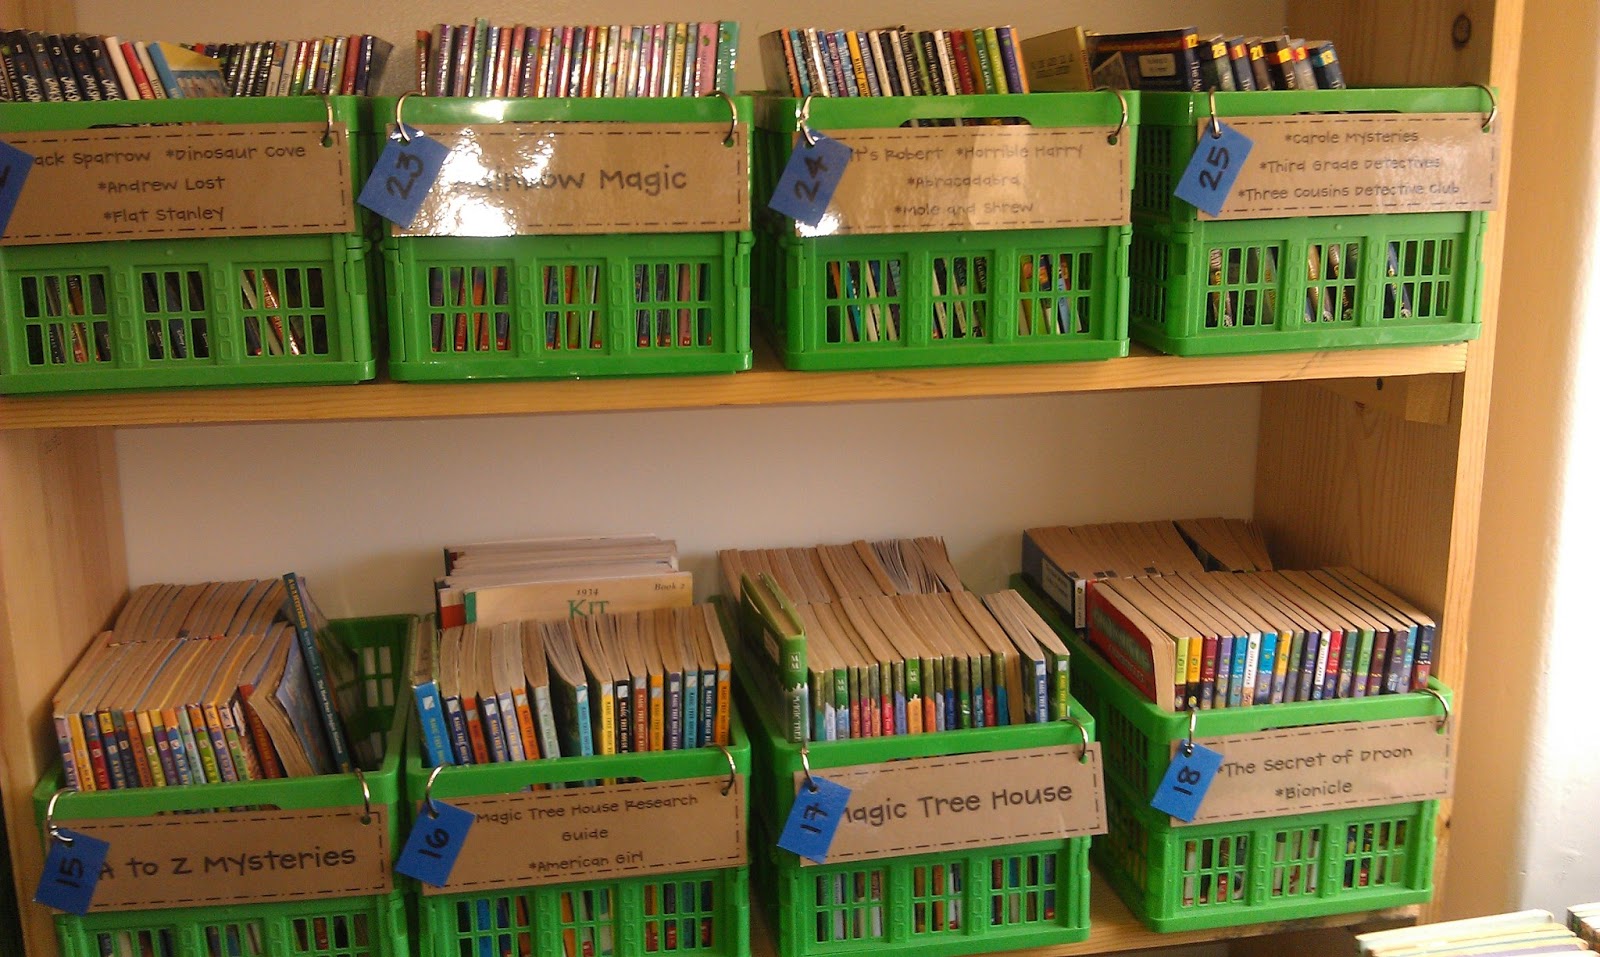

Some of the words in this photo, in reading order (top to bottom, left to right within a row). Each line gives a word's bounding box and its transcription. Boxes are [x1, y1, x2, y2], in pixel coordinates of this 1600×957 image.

[1345, 130, 1418, 144] Mysteries
[34, 151, 65, 166] ack
[73, 151, 151, 168] Sparrow
[264, 145, 306, 158] Cove
[884, 147, 943, 161] Robert
[1035, 143, 1084, 158] Harry
[1312, 157, 1359, 171] Grade
[1364, 156, 1441, 170] Detectives
[386, 151, 425, 199] 23
[600, 164, 687, 196] Magic
[795, 154, 829, 203] 24
[1199, 146, 1230, 191] 25
[185, 176, 226, 191] Lost
[1295, 185, 1349, 198] Cousins
[1355, 184, 1424, 197] Detective
[1428, 182, 1460, 194] Club
[156, 206, 225, 222] Stanley
[947, 201, 975, 215] and
[983, 201, 1033, 214] Shrew
[654, 583, 676, 591] Book
[568, 599, 609, 618] KIT
[1264, 753, 1323, 771] Secret
[1333, 750, 1354, 765] of
[1361, 746, 1413, 760] Droon
[1173, 766, 1200, 796] 18
[476, 808, 522, 824] Magic
[528, 806, 565, 820] Tree
[571, 801, 619, 816] House
[625, 794, 698, 810] Research
[917, 793, 980, 818] Tree
[992, 783, 1073, 810] House
[800, 803, 829, 834] 17
[418, 828, 449, 860] 16
[561, 827, 609, 842] Guide
[99, 861, 115, 880] A
[125, 857, 158, 878] to
[171, 857, 193, 874] Z
[204, 845, 356, 877] Mysteries
[616, 851, 643, 865] Girl
[55, 857, 84, 889] 15
